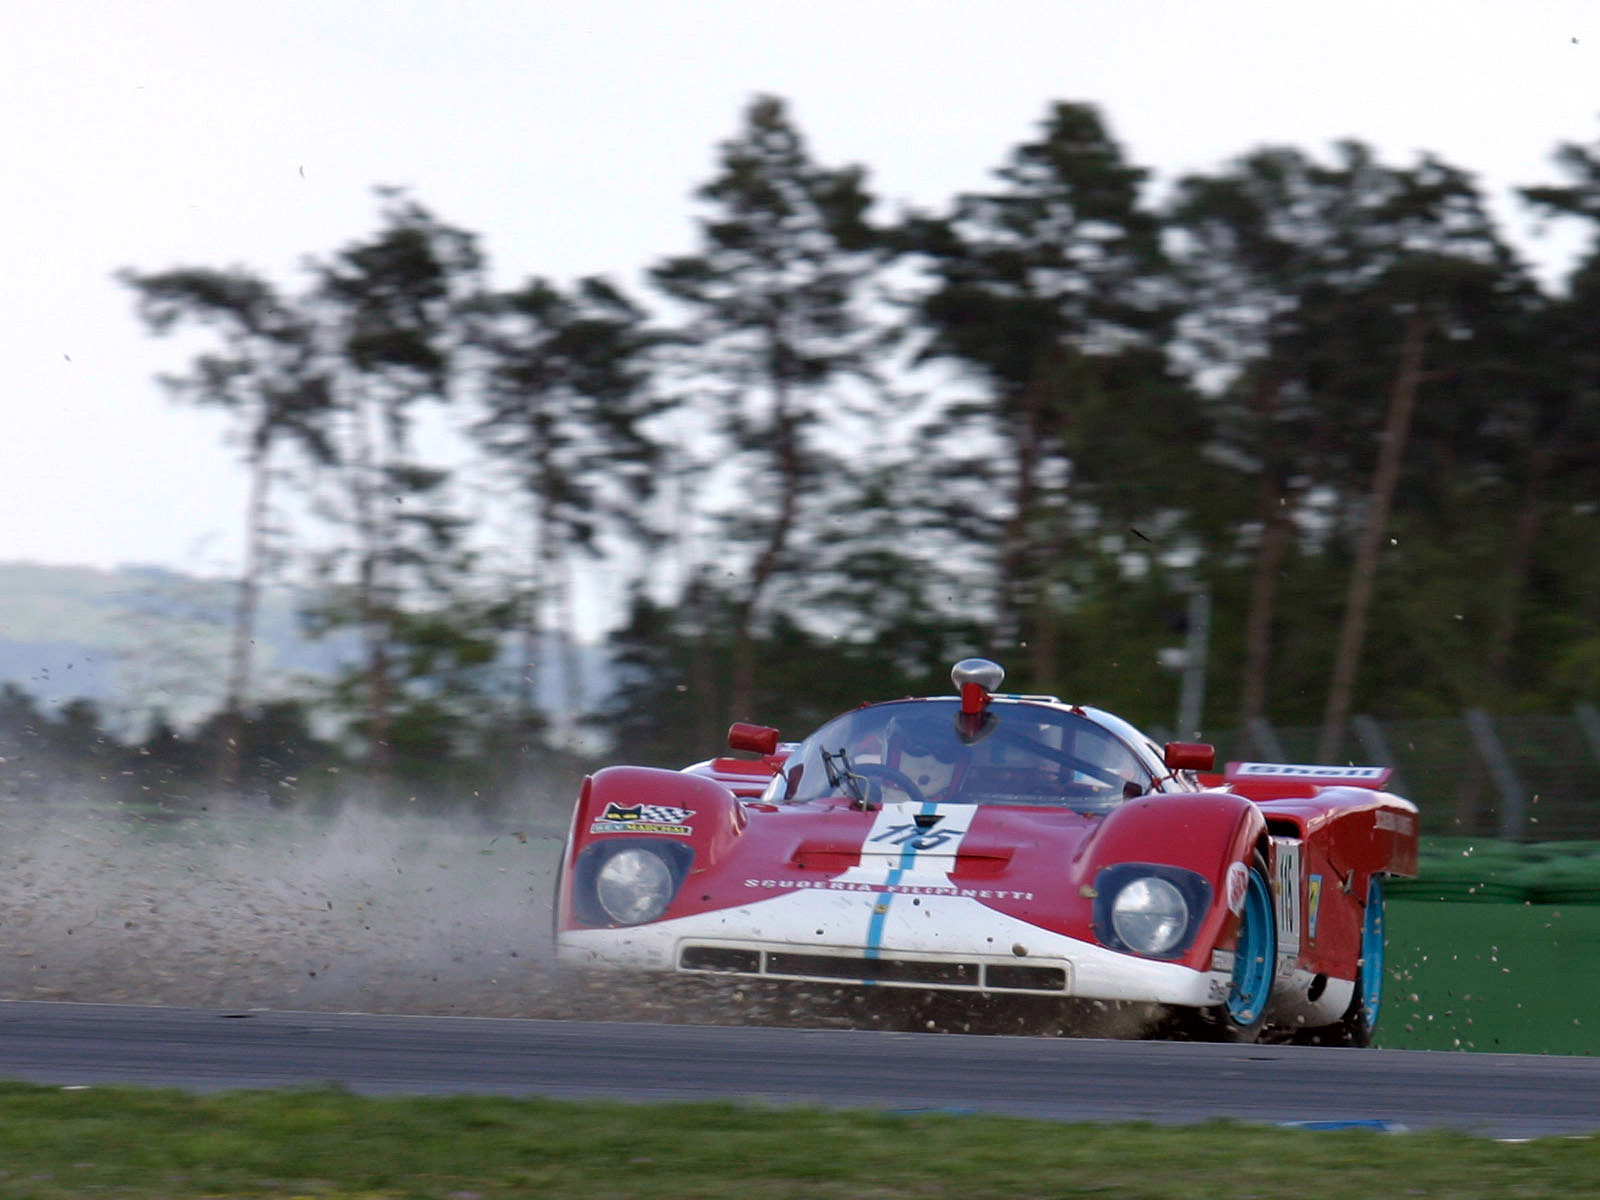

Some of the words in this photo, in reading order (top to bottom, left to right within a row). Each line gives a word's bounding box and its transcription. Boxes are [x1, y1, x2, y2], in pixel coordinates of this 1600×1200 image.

[1248, 765, 1373, 776] Shell
[869, 824, 966, 850] 115
[744, 879, 872, 891] SCUDERIA
